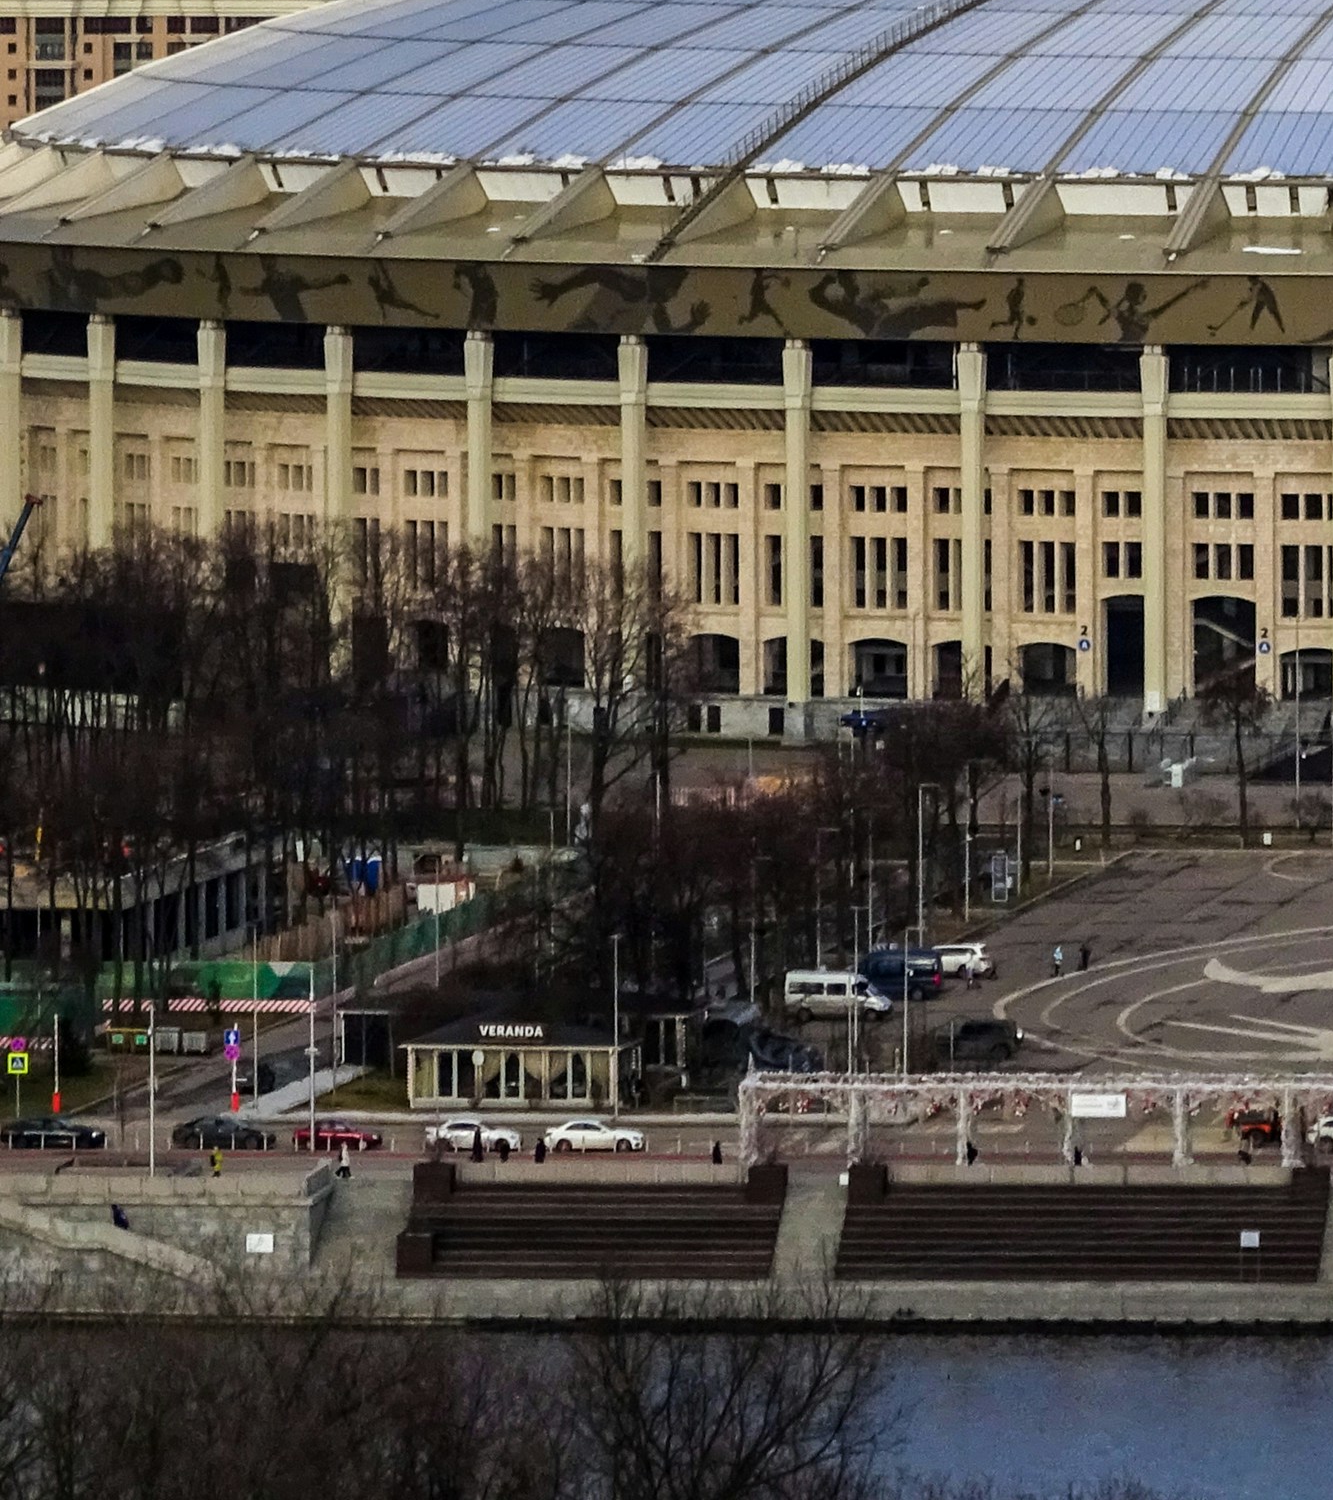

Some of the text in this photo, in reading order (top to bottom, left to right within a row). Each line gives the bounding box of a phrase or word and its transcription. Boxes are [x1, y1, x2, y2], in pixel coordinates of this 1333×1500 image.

[1080, 625, 1088, 636] 2
[1260, 627, 1269, 639] 2
[479, 1025, 543, 1037] VERANDA
